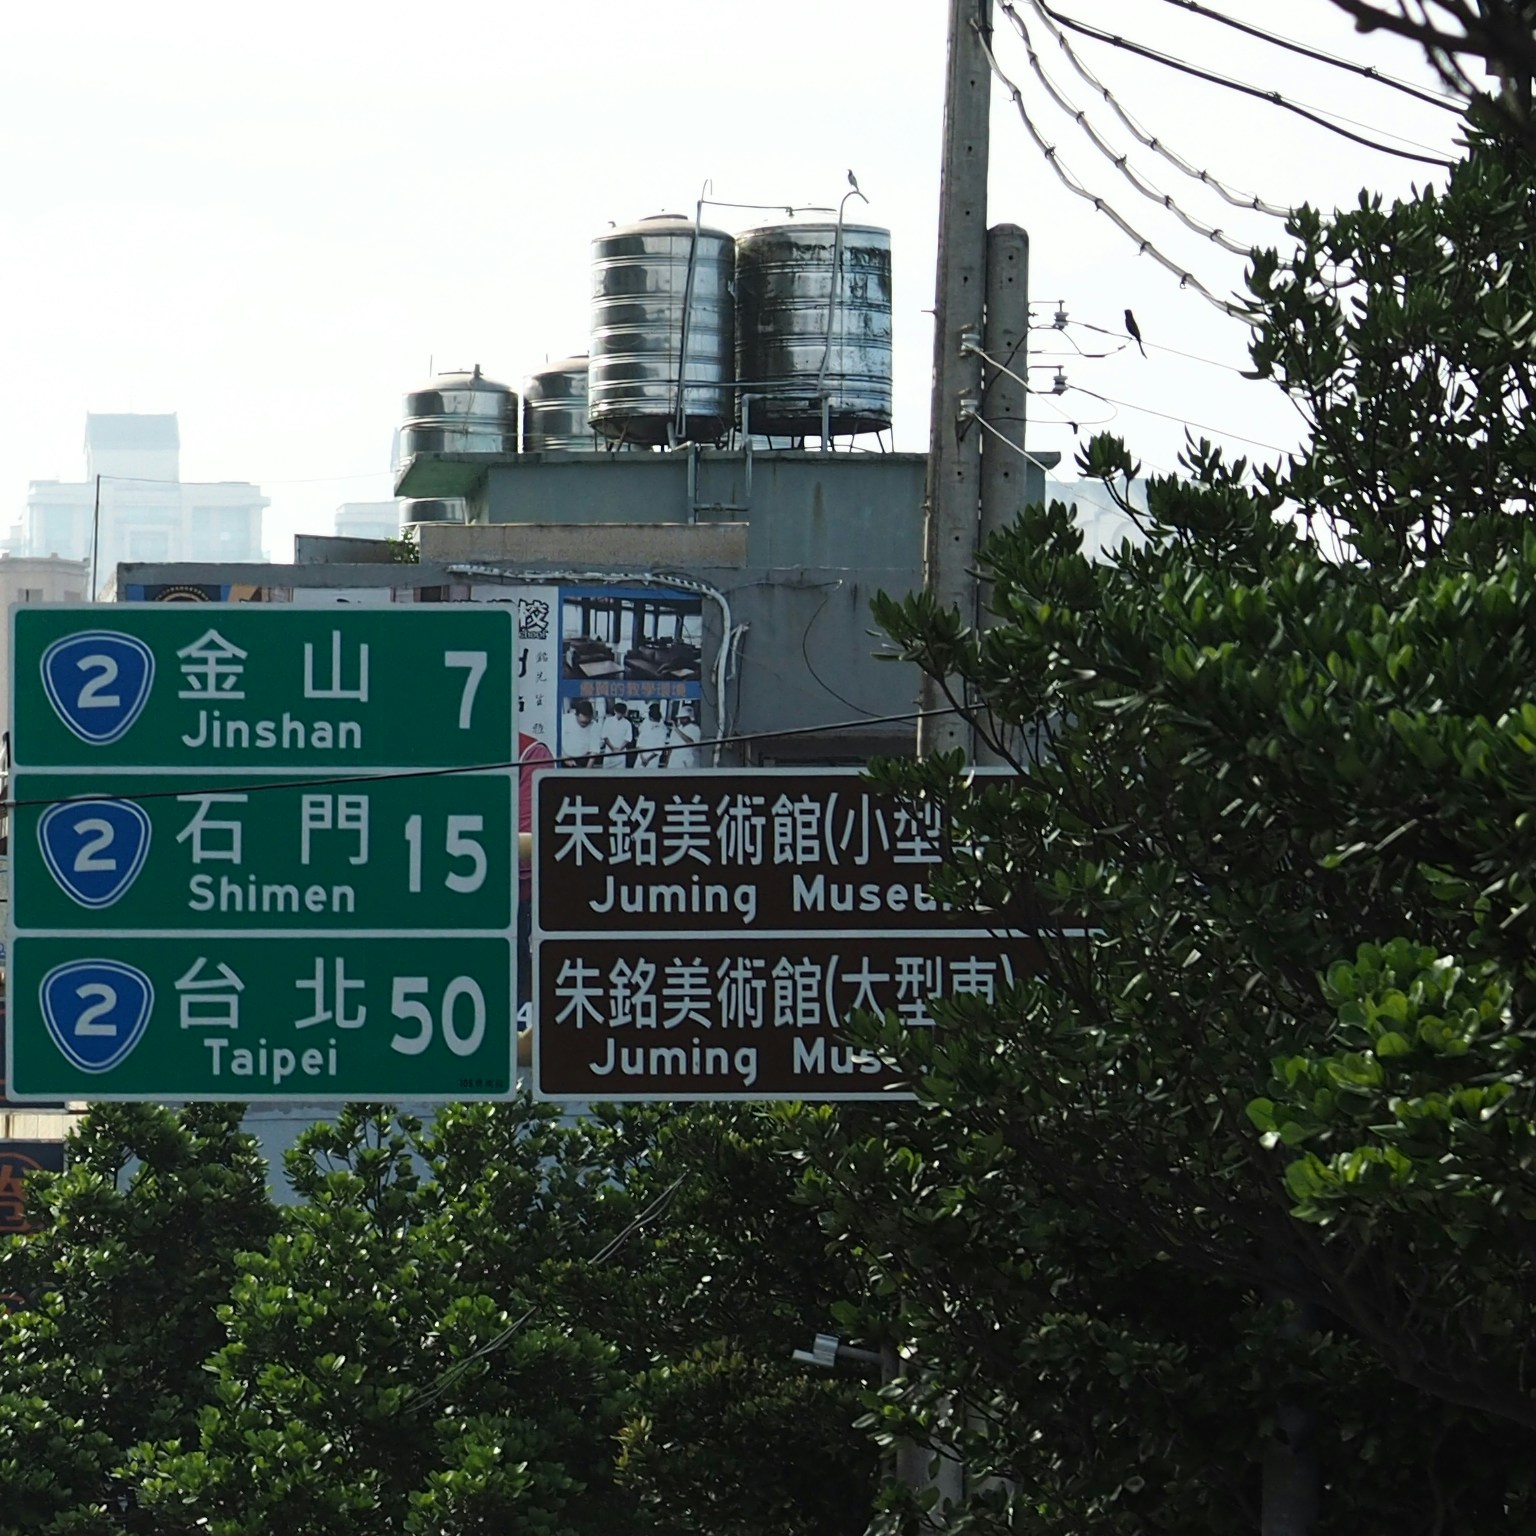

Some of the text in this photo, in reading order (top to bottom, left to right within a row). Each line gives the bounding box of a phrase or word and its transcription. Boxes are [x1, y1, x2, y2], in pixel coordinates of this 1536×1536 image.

[77, 654, 121, 708] 2
[175, 628, 370, 703] 金山
[444, 650, 488, 730] 7
[181, 710, 362, 750] Jinshan
[73, 818, 117, 871] 2
[176, 793, 370, 866] 石門
[405, 814, 488, 894] 15
[553, 793, 990, 867] 朱銘美術館(小型
[187, 873, 355, 913] Shimen
[589, 874, 978, 924] Juming Museu
[74, 983, 118, 1036] 2
[173, 956, 367, 1031] 台北
[390, 975, 487, 1056] 50
[203, 1038, 339, 1085] Taipei
[589, 1038, 758, 1086] Juming
